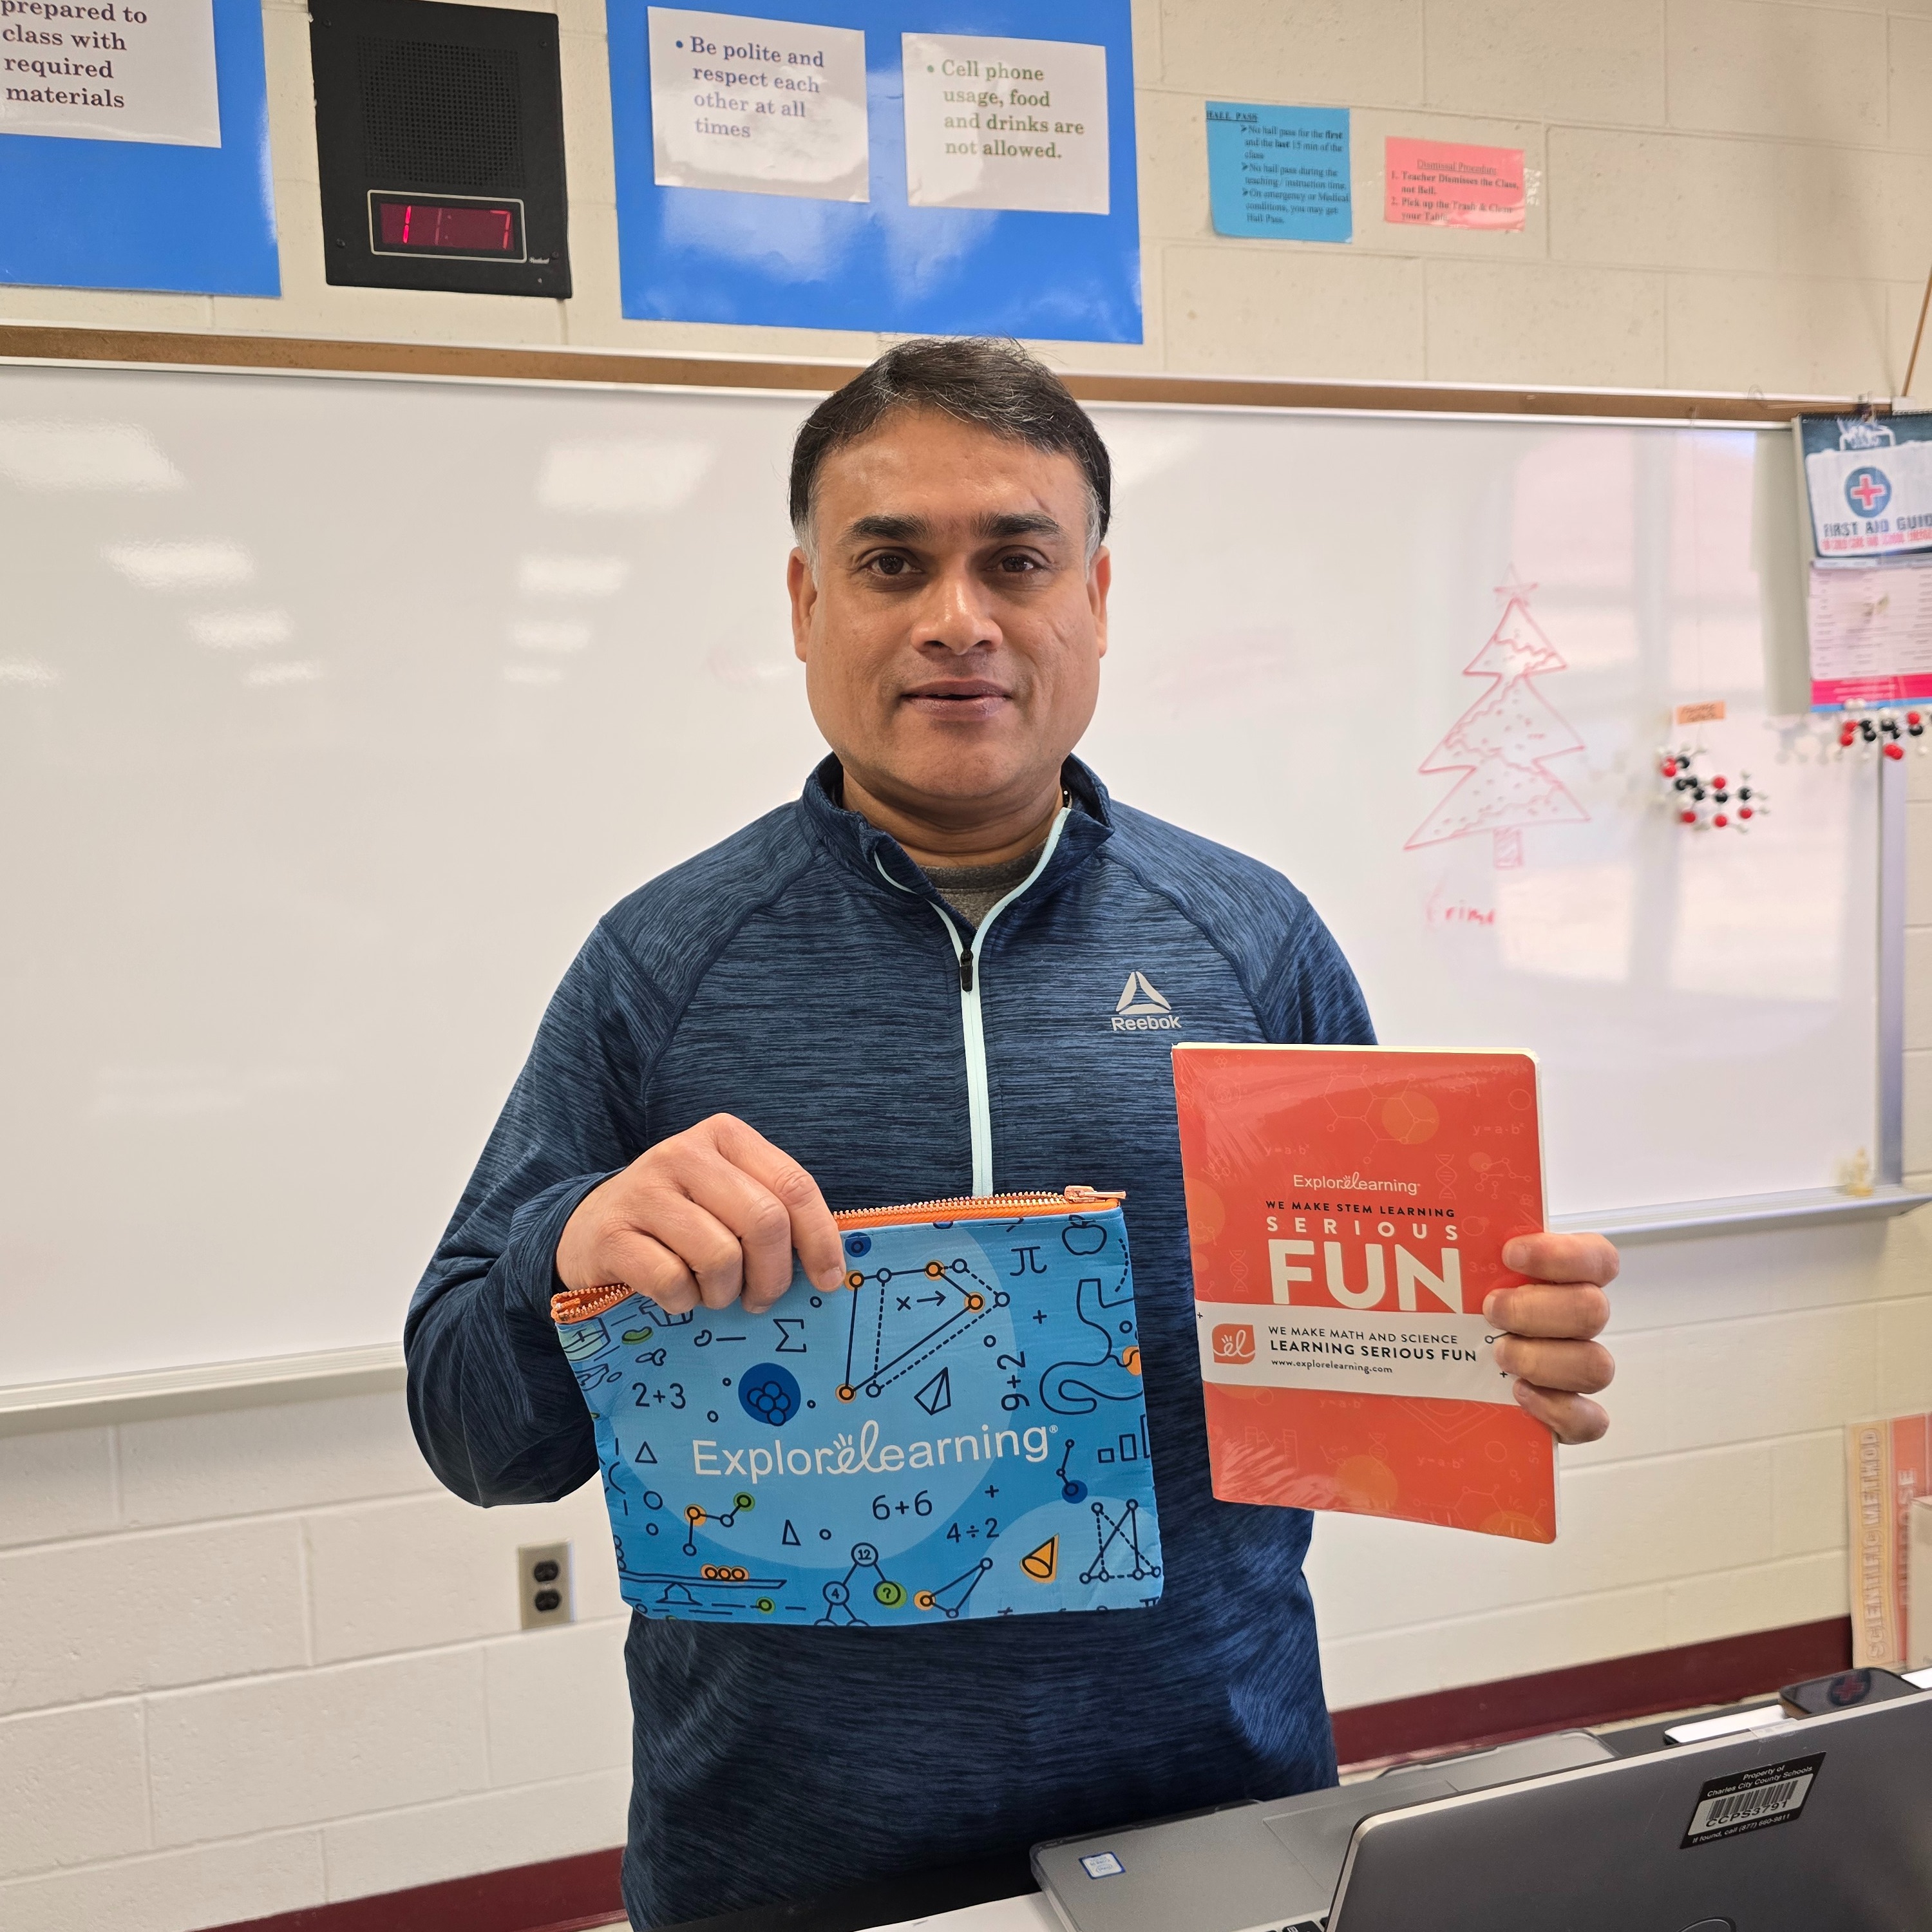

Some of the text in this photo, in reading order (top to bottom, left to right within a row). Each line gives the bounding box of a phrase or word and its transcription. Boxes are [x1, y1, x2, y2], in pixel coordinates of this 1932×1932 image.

[1, 0, 147, 24] prepared to
[3, 24, 127, 50] class with
[690, 35, 824, 67] Be polite and
[4, 58, 114, 79] required
[942, 59, 1045, 82] Cell phone
[692, 67, 820, 93] respect each
[6, 86, 124, 108] materials
[694, 91, 806, 117] other at all
[943, 89, 1050, 107] usage, food
[695, 118, 751, 138] times
[944, 113, 1085, 135] and drinks are
[1262, 126, 1276, 135] hall
[1311, 129, 1323, 138] the
[945, 140, 1062, 158] not allowed.
[1244, 137, 1258, 146] and
[1261, 138, 1273, 147] the
[1331, 143, 1342, 152] the
[1264, 164, 1278, 173] hall
[1299, 166, 1323, 178] during
[1325, 168, 1338, 177] the
[1402, 171, 1435, 182] Teacher
[1439, 174, 1478, 185] Dismisses
[1481, 176, 1492, 186] the
[1285, 180, 1326, 189] instruction
[1264, 191, 1305, 202] emergency
[1401, 197, 1420, 207] Pick
[1436, 198, 1449, 209] the
[1291, 205, 1305, 214] you
[1307, 207, 1323, 216] may
[1824, 522, 1857, 537] FIRST
[1866, 519, 1889, 533] AID
[1112, 1015, 1182, 1031] Reebok
[1265, 1200, 1455, 1218] WE MAKE STEM LEARNING
[1266, 1217, 1458, 1240] SERIOUS
[1268, 1239, 1463, 1314] FUN
[1268, 1326, 1458, 1344] WE MAKE MATH AND SCIENCE
[1270, 1340, 1477, 1361] LEARNING SERIOUS FUN
[1271, 1359, 1393, 1374] www.explorelearning.com
[632, 1382, 687, 1409] 2+3
[872, 1490, 933, 1520] 6+6
[858, 1549, 872, 1561] 12
[831, 1587, 840, 1599] 4
[1707, 1766, 1812, 1797] Charles City County Schools
[1743, 1768, 1774, 1780] Property
[1706, 1799, 1788, 1827] CCPS3791
[1700, 1831, 1722, 1842] found,
[1724, 1827, 1738, 1835] call
[1739, 1822, 1757, 1833] (877)
